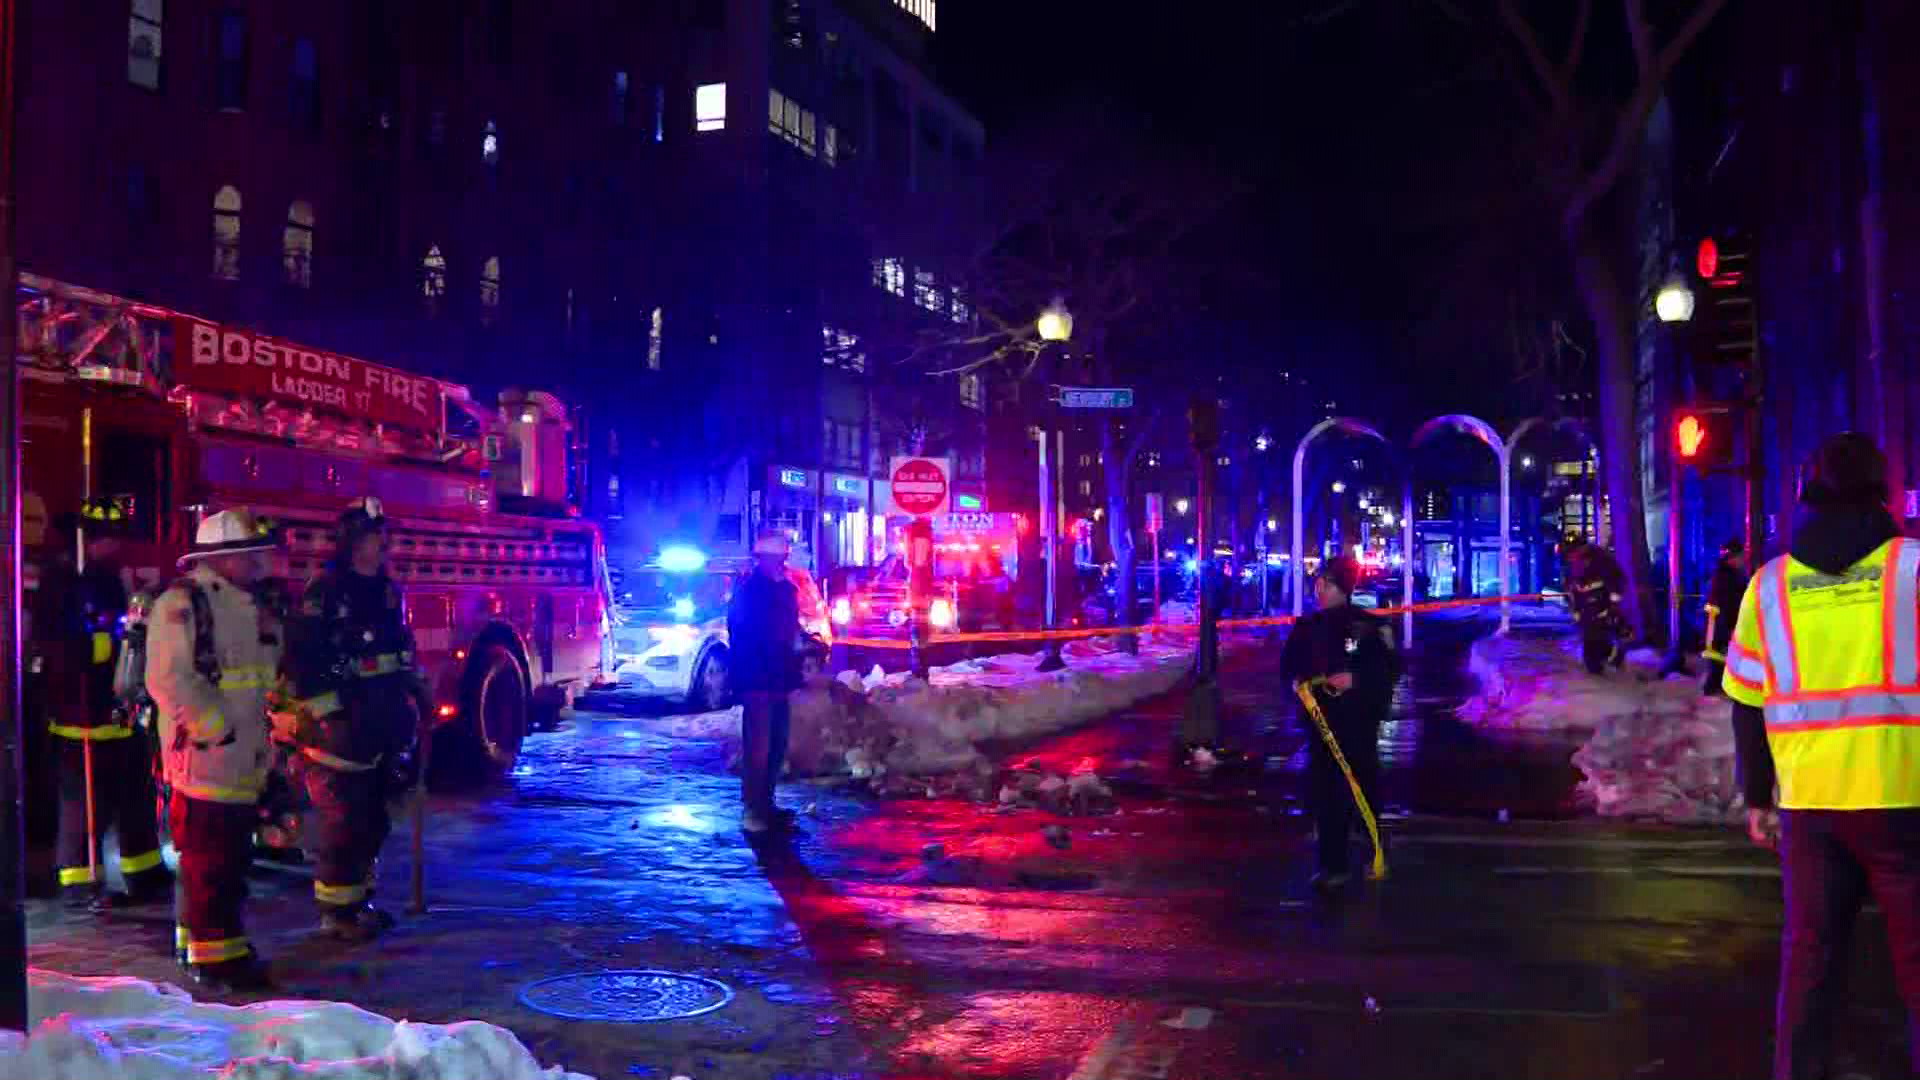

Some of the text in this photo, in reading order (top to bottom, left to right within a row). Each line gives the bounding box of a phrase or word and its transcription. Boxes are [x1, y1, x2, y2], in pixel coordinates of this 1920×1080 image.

[192, 323, 427, 416] BOSTON FIRE
[272, 371, 346, 408] LADDER
